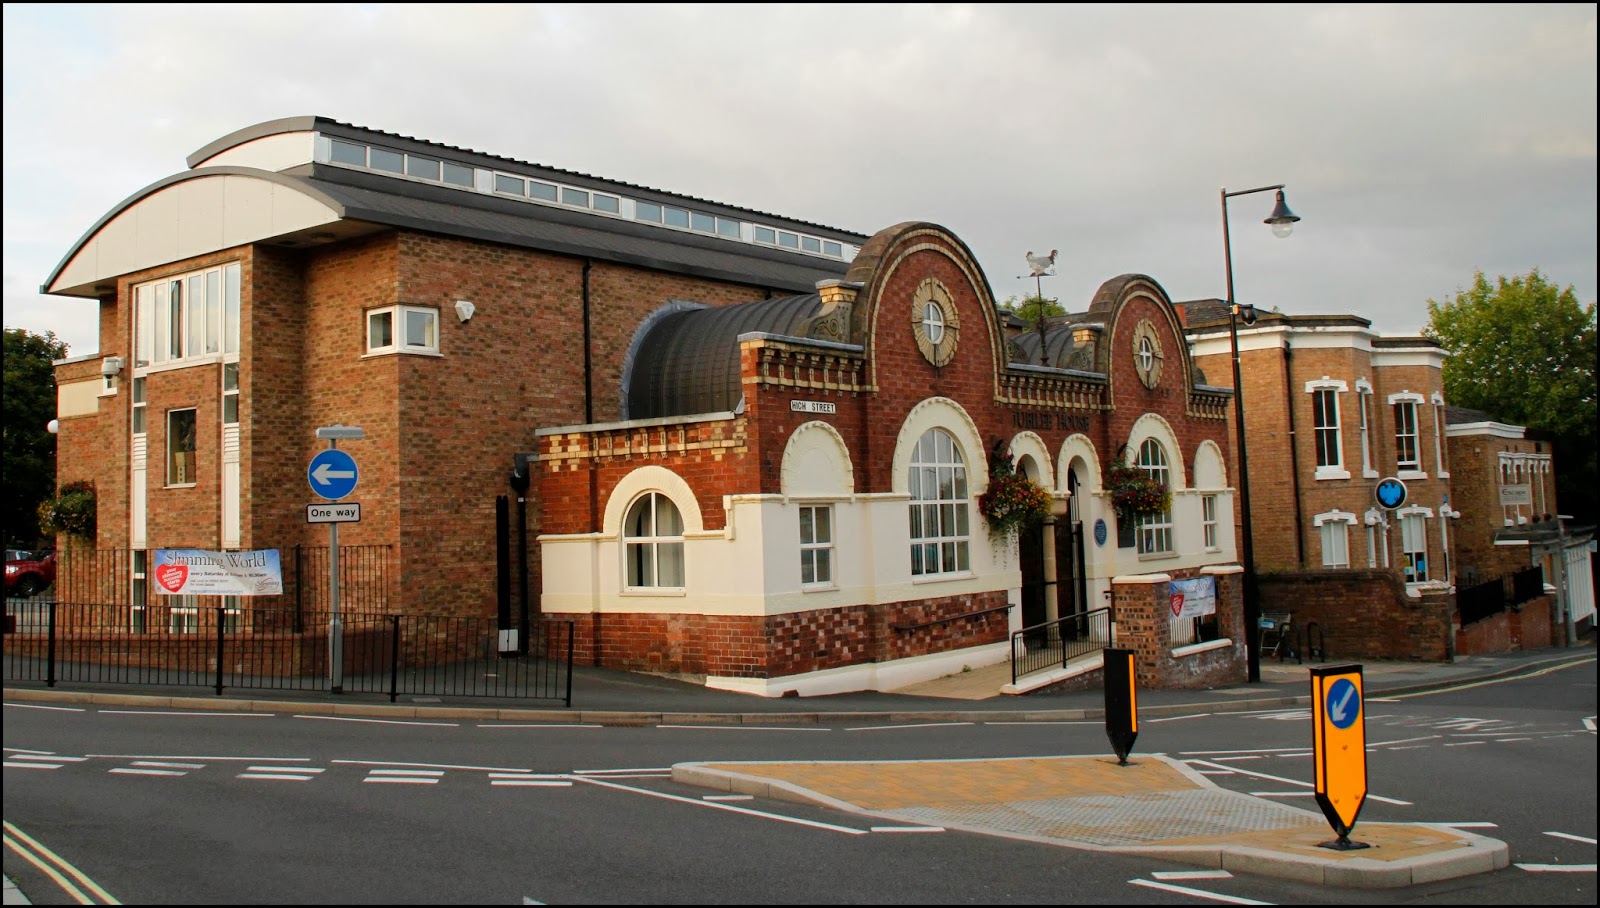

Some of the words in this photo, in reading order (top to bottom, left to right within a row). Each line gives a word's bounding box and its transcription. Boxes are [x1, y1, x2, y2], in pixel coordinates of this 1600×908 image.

[792, 401, 806, 410] HIGH
[811, 403, 834, 412] STREET
[1012, 411, 1052, 430] JUBILEE
[1056, 413, 1089, 431] HOUSE
[311, 509, 331, 517] One
[336, 509, 355, 517] way
[165, 551, 225, 569] Slimming
[226, 552, 266, 568] World
